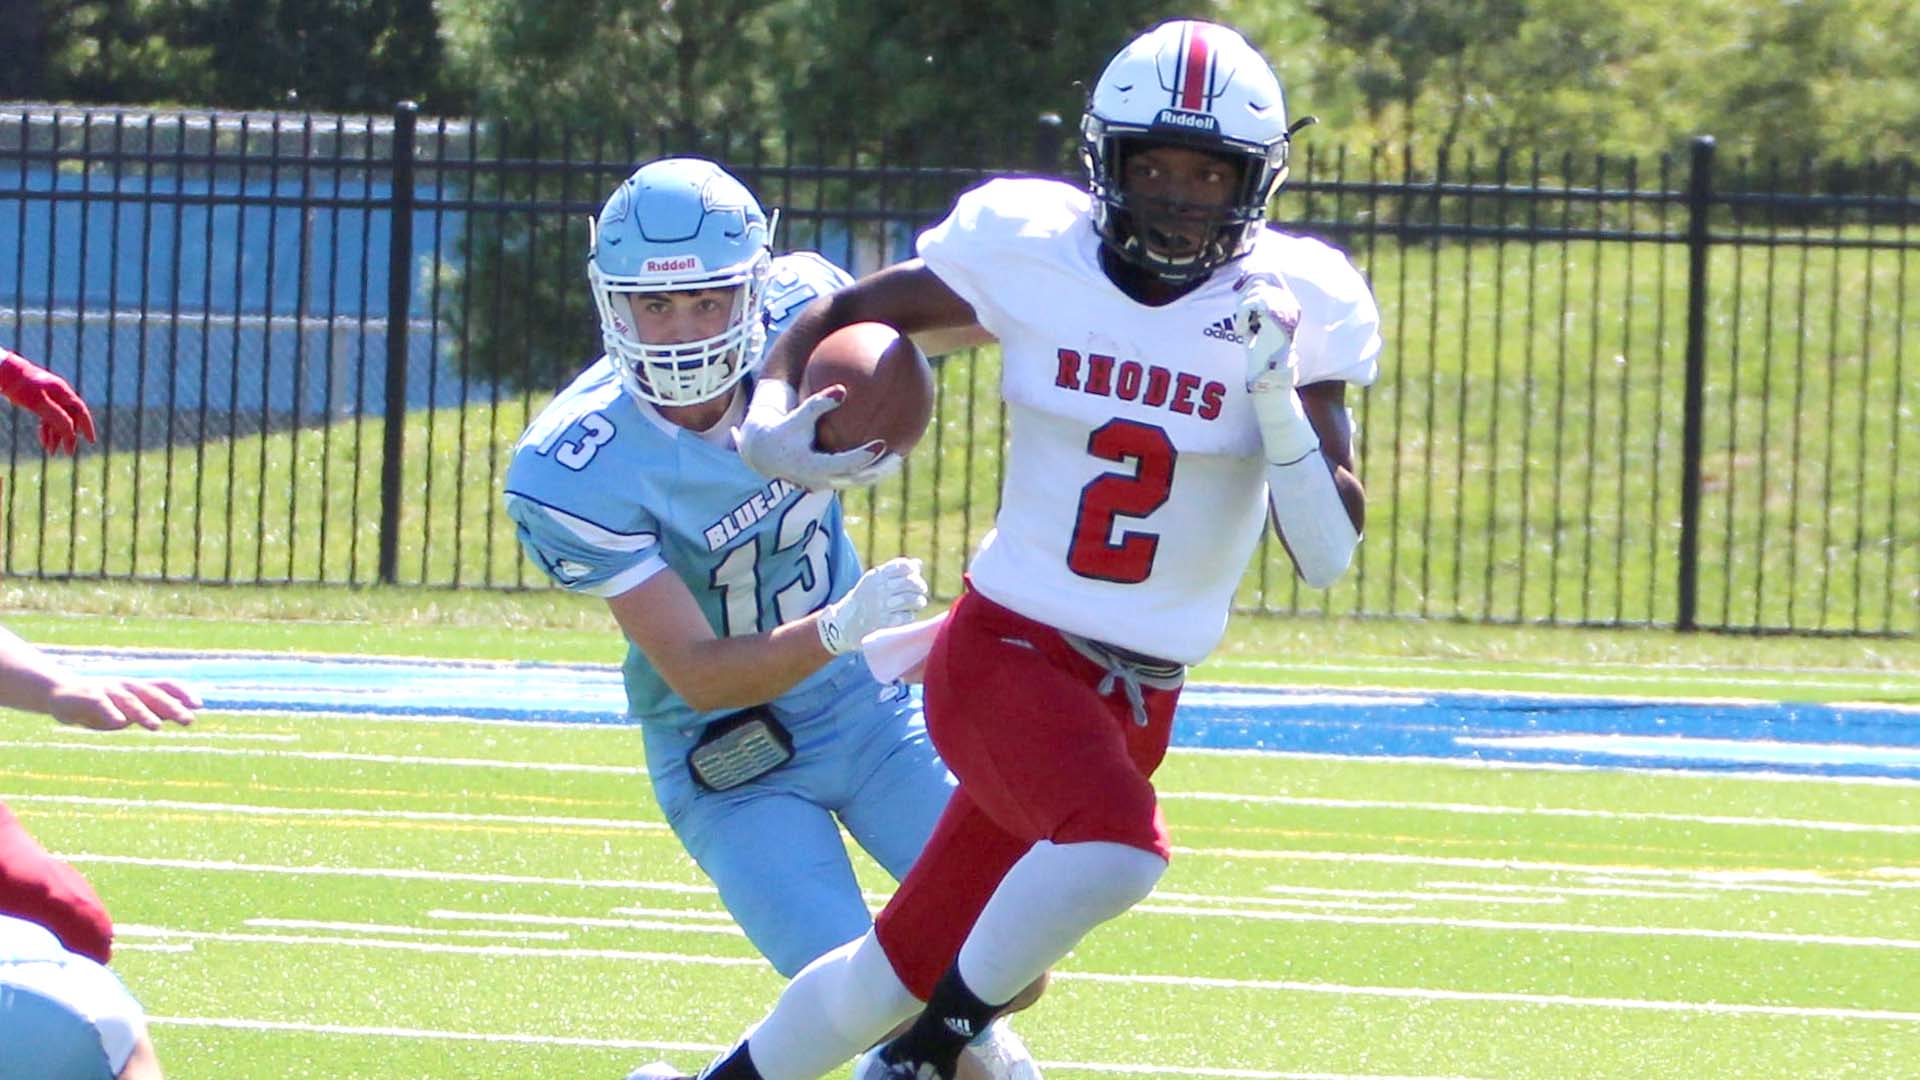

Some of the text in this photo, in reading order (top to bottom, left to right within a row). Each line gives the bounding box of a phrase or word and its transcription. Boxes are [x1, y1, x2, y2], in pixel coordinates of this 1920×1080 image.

[1161, 111, 1215, 130] Riddell
[647, 258, 696, 272] Riddell
[1203, 327, 1245, 344] adida
[1055, 348, 1226, 421] RHODES
[1067, 416, 1178, 584] 2
[709, 485, 833, 638] 13
